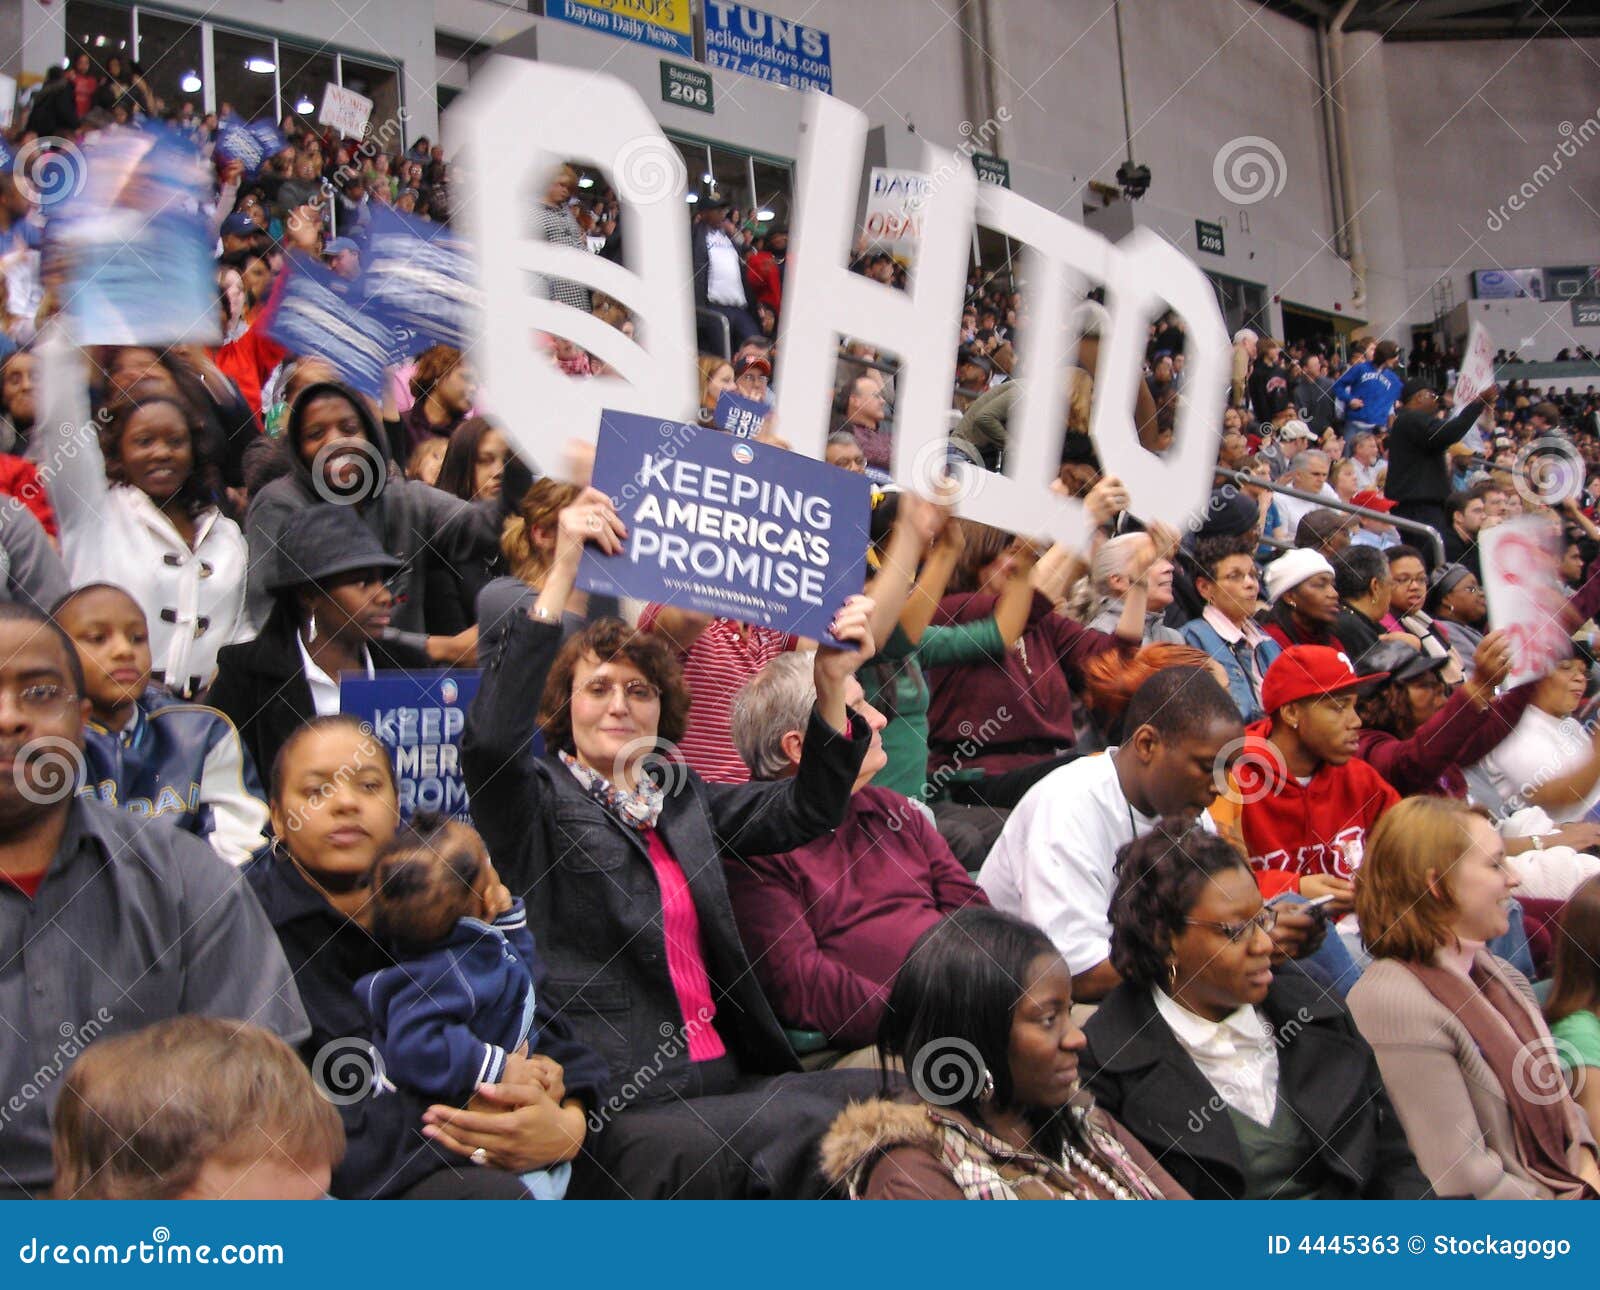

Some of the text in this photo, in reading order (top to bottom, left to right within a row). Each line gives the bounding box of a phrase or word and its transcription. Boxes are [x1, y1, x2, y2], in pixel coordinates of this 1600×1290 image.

[564, 1, 678, 47] Dayton Daily News
[708, 0, 824, 58] TUNS
[705, 28, 832, 79] acliquidators.com
[669, 67, 706, 88] Section
[669, 81, 708, 106] 206
[979, 169, 1006, 187] 207
[1202, 235, 1221, 250] 208
[445, 55, 1230, 555] OHIO
[1578, 312, 1600, 322] 20
[640, 453, 832, 530] KEEPING
[633, 493, 830, 567] AMERICA'S
[630, 527, 826, 607] PROMISE
[393, 743, 464, 779] MER
